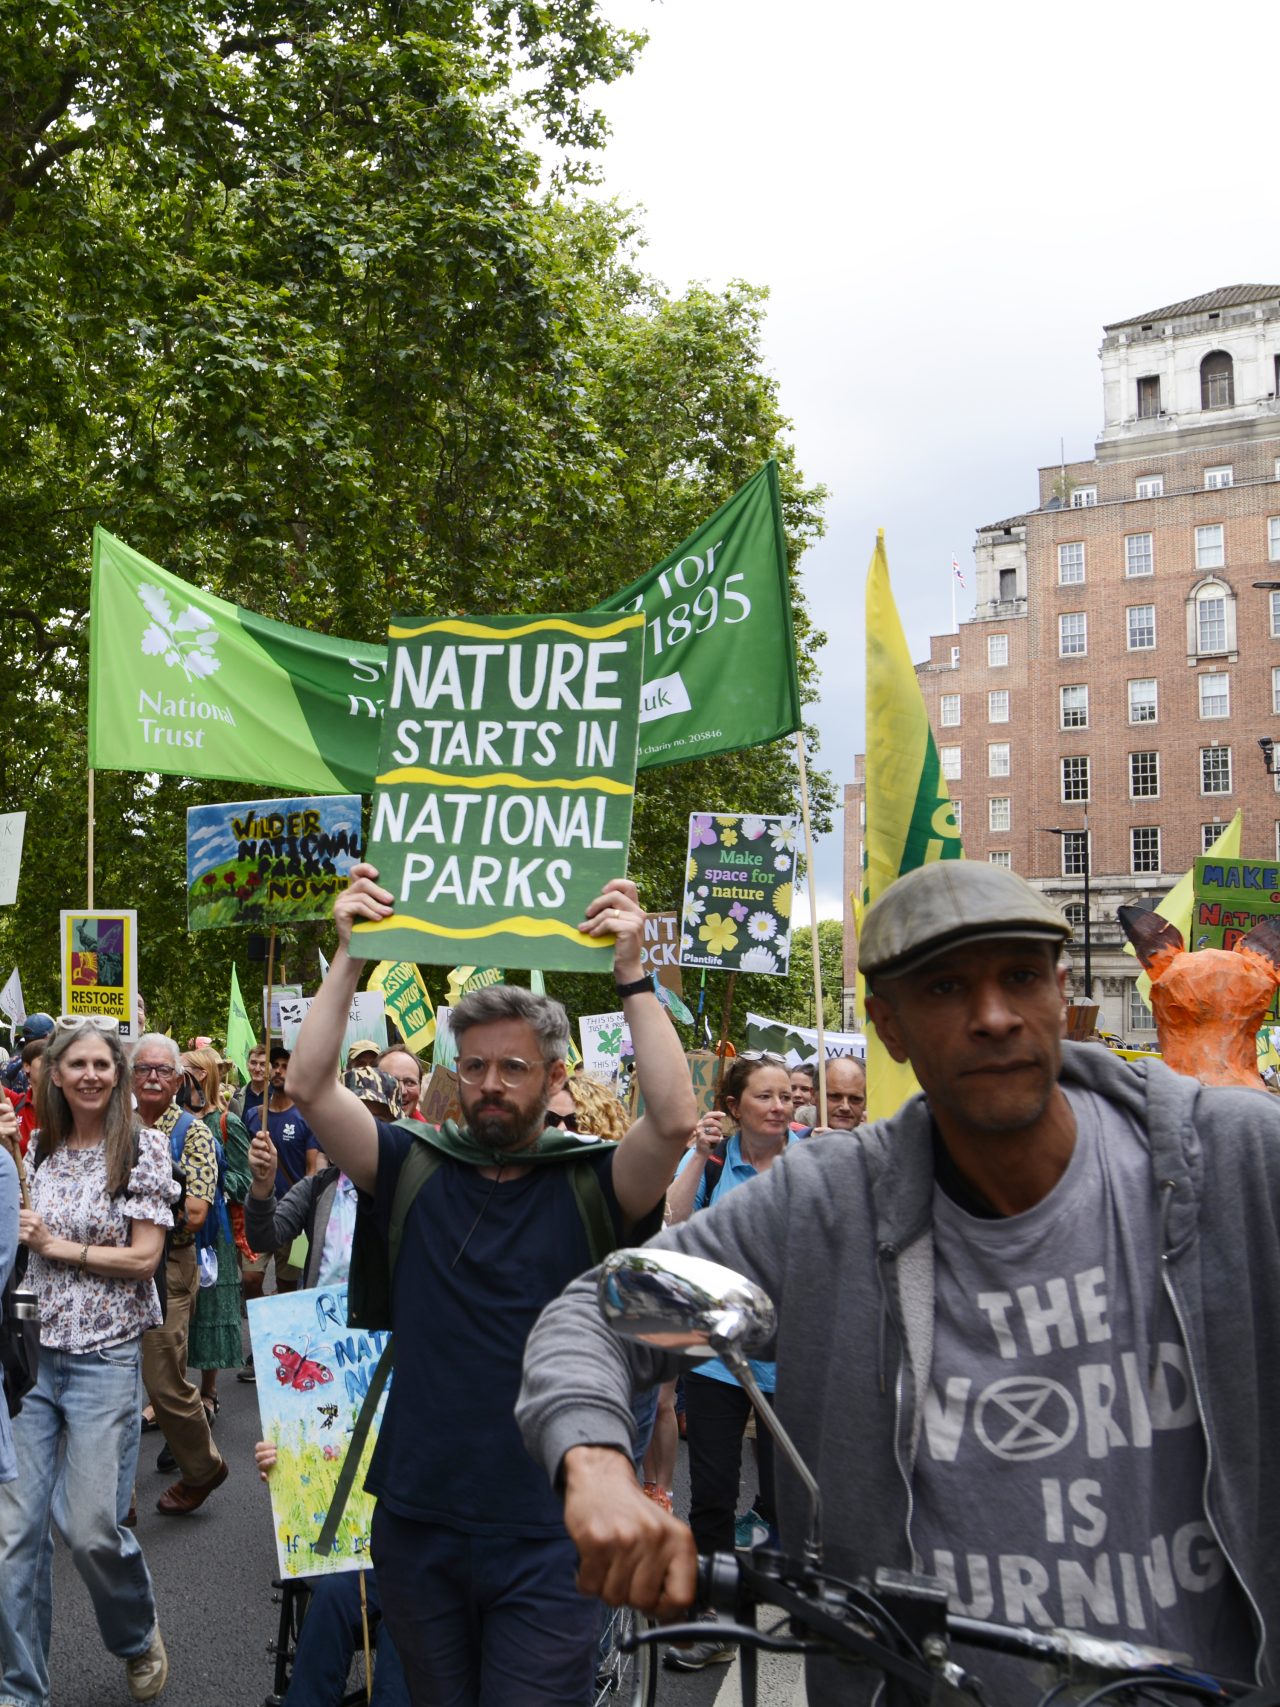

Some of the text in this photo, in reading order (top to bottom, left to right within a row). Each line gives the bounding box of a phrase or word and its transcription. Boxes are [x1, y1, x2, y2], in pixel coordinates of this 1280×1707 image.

[648, 573, 751, 655] 1895
[389, 641, 628, 711] NATURE
[138, 689, 236, 727] National
[138, 719, 206, 749] Trust
[392, 719, 618, 768] STARTS IN
[688, 729, 723, 743] 205846
[231, 810, 321, 841] WILDER
[372, 792, 624, 850] NATIONAL
[720, 850, 763, 866] Make
[400, 853, 572, 909] PARKS
[705, 868, 775, 883] space for
[1202, 864, 1279, 890] MAKE
[712, 886, 765, 900] nature
[683, 953, 723, 965] Plantlife
[72, 991, 124, 1005] RESTORE
[72, 1005, 124, 1016] NATURE NOW
[592, 1061, 609, 1069] THIS
[977, 1266, 1112, 1359] THE
[1041, 1477, 1108, 1547] IS
[286, 1535, 300, 1554] If
